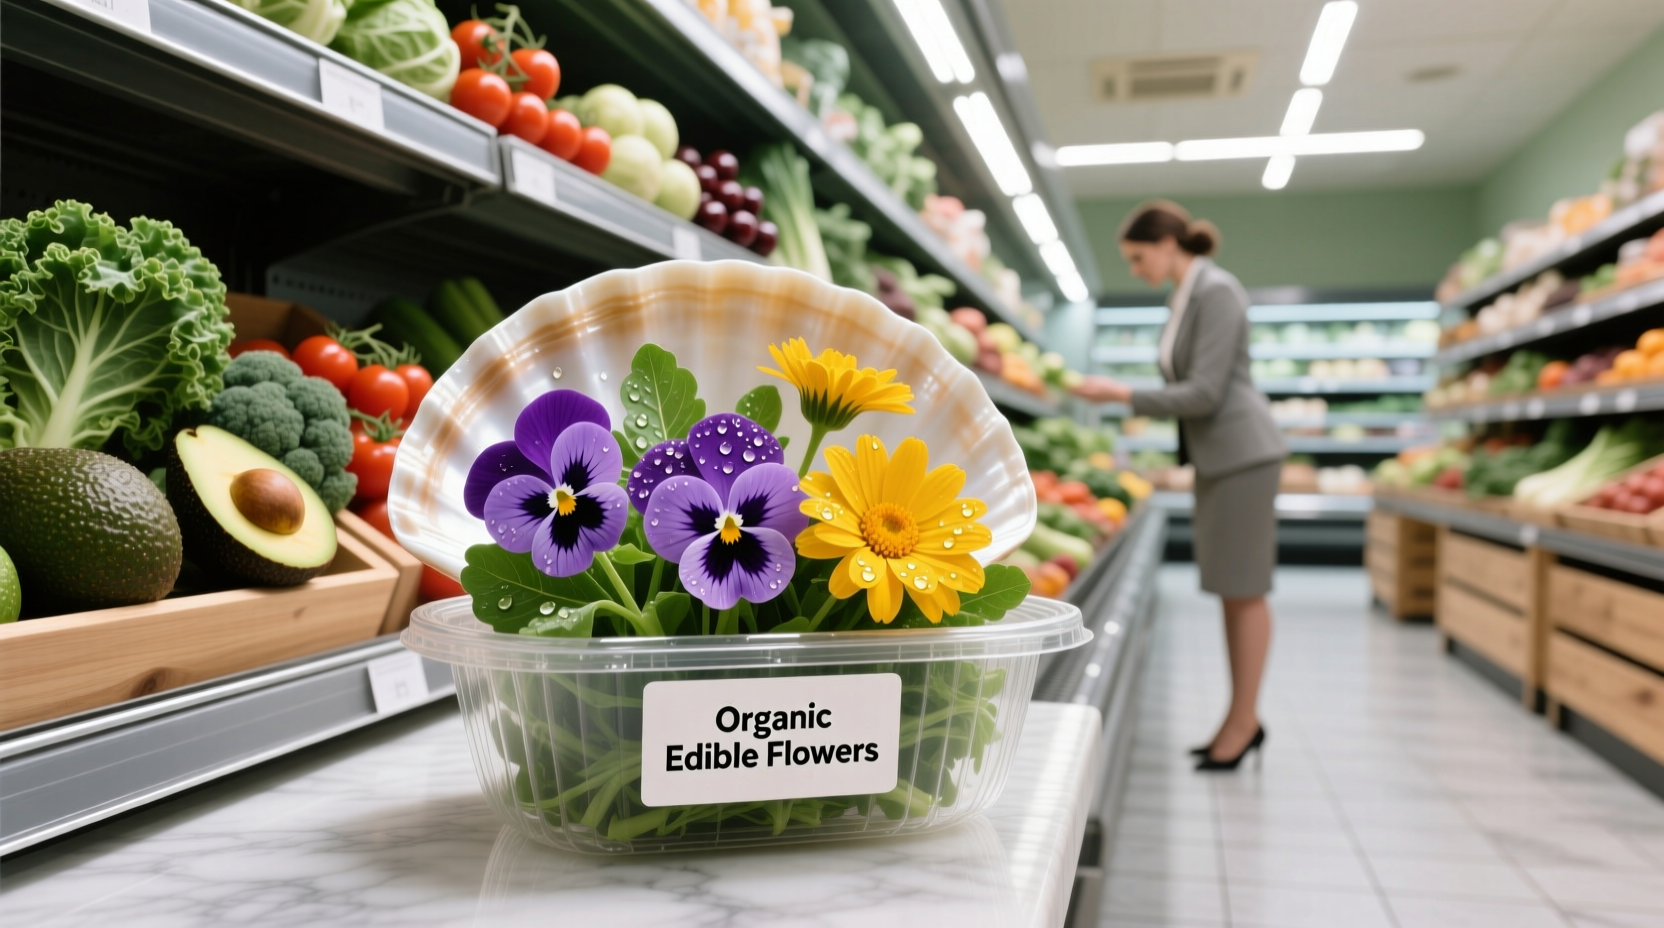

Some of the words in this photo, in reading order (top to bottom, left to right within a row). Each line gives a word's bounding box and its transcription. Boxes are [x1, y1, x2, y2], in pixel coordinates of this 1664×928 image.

[715, 702, 832, 739] Organic
[666, 741, 759, 772] Edible
[767, 740, 879, 767] Flowers
